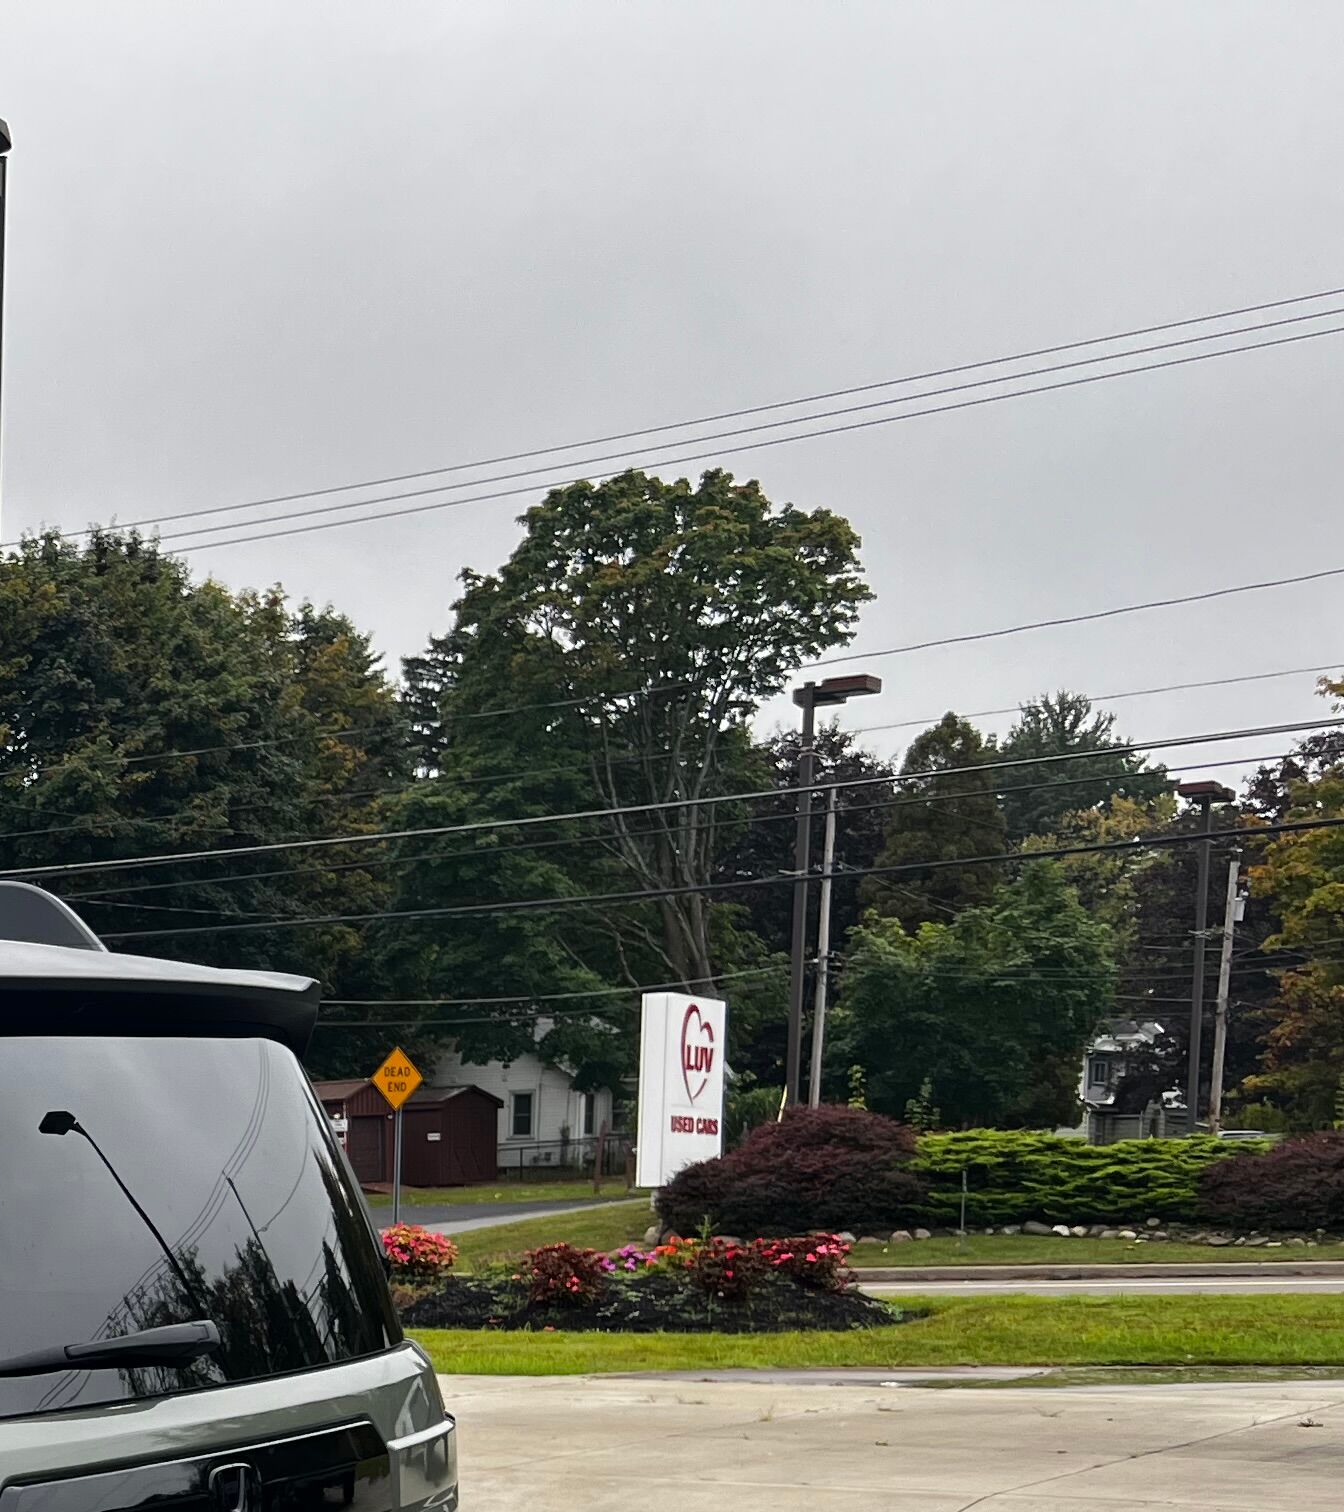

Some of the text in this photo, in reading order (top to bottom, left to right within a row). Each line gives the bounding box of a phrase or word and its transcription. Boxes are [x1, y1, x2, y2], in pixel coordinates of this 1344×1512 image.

[685, 1044, 714, 1073] LUV
[384, 1066, 411, 1078] DEAD
[387, 1082, 407, 1093] END
[670, 1115, 719, 1136] USED CARS
